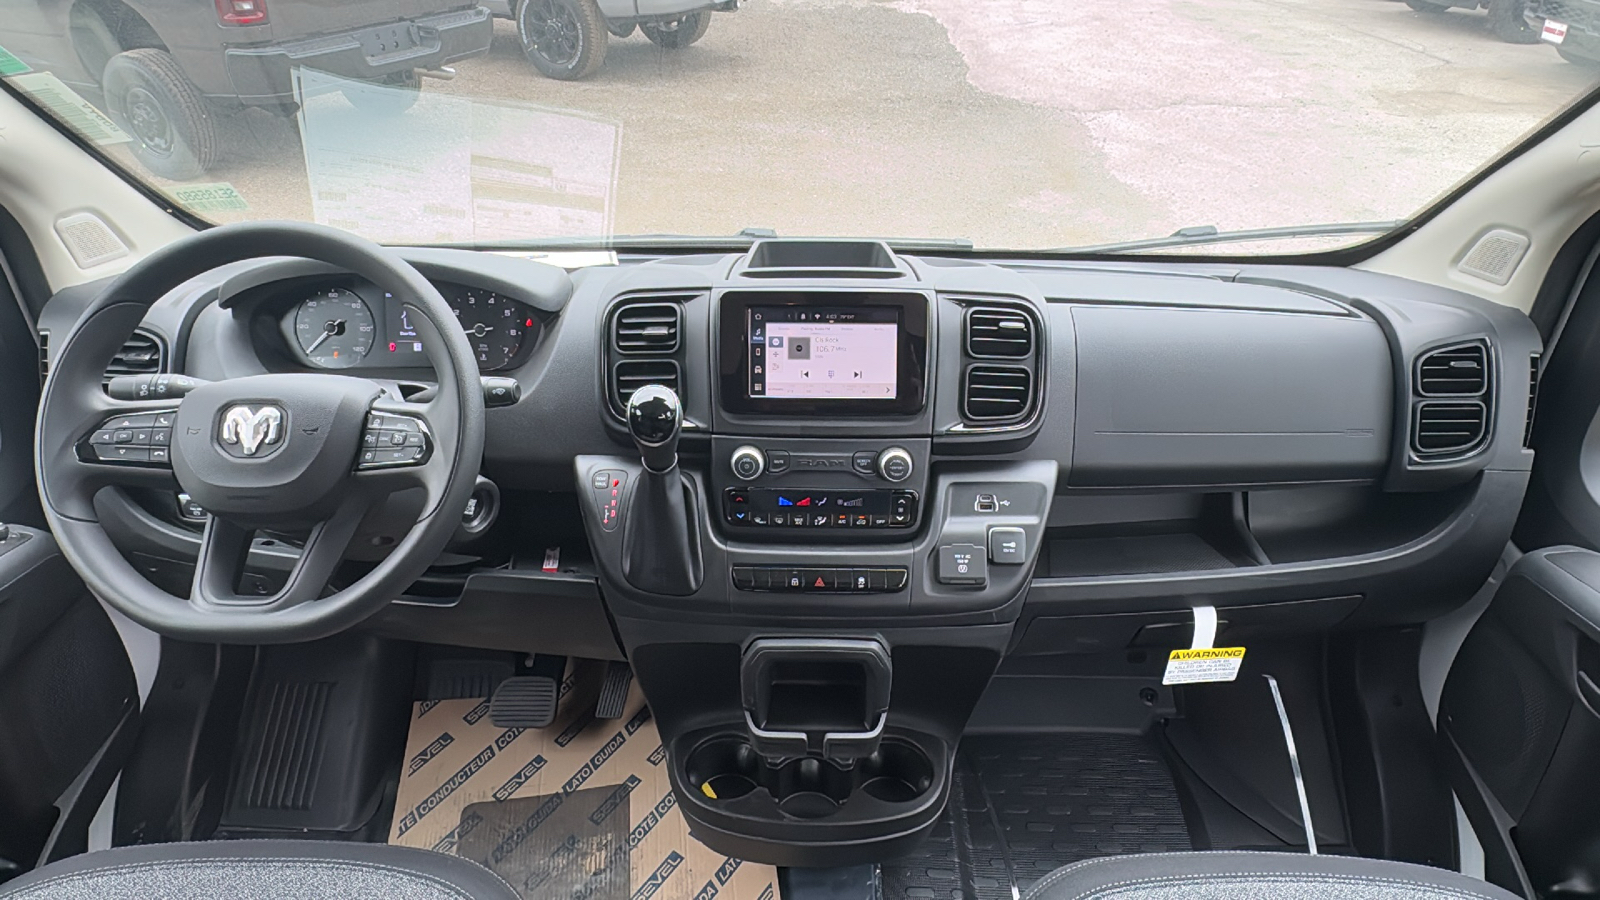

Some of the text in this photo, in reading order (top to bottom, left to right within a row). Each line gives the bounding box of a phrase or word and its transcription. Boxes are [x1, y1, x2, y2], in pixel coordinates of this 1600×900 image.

[504, 309, 511, 317] 5
[815, 345, 835, 353] 106.7
[613, 479, 619, 487] P
[611, 509, 616, 517] D
[1182, 649, 1243, 659] WARNING
[566, 767, 591, 793] LATO
[594, 734, 624, 766] GUIDA
[419, 749, 493, 815] CONDUCTEUR
[496, 759, 544, 801] SEVEL
[593, 779, 638, 822] SEVEL
